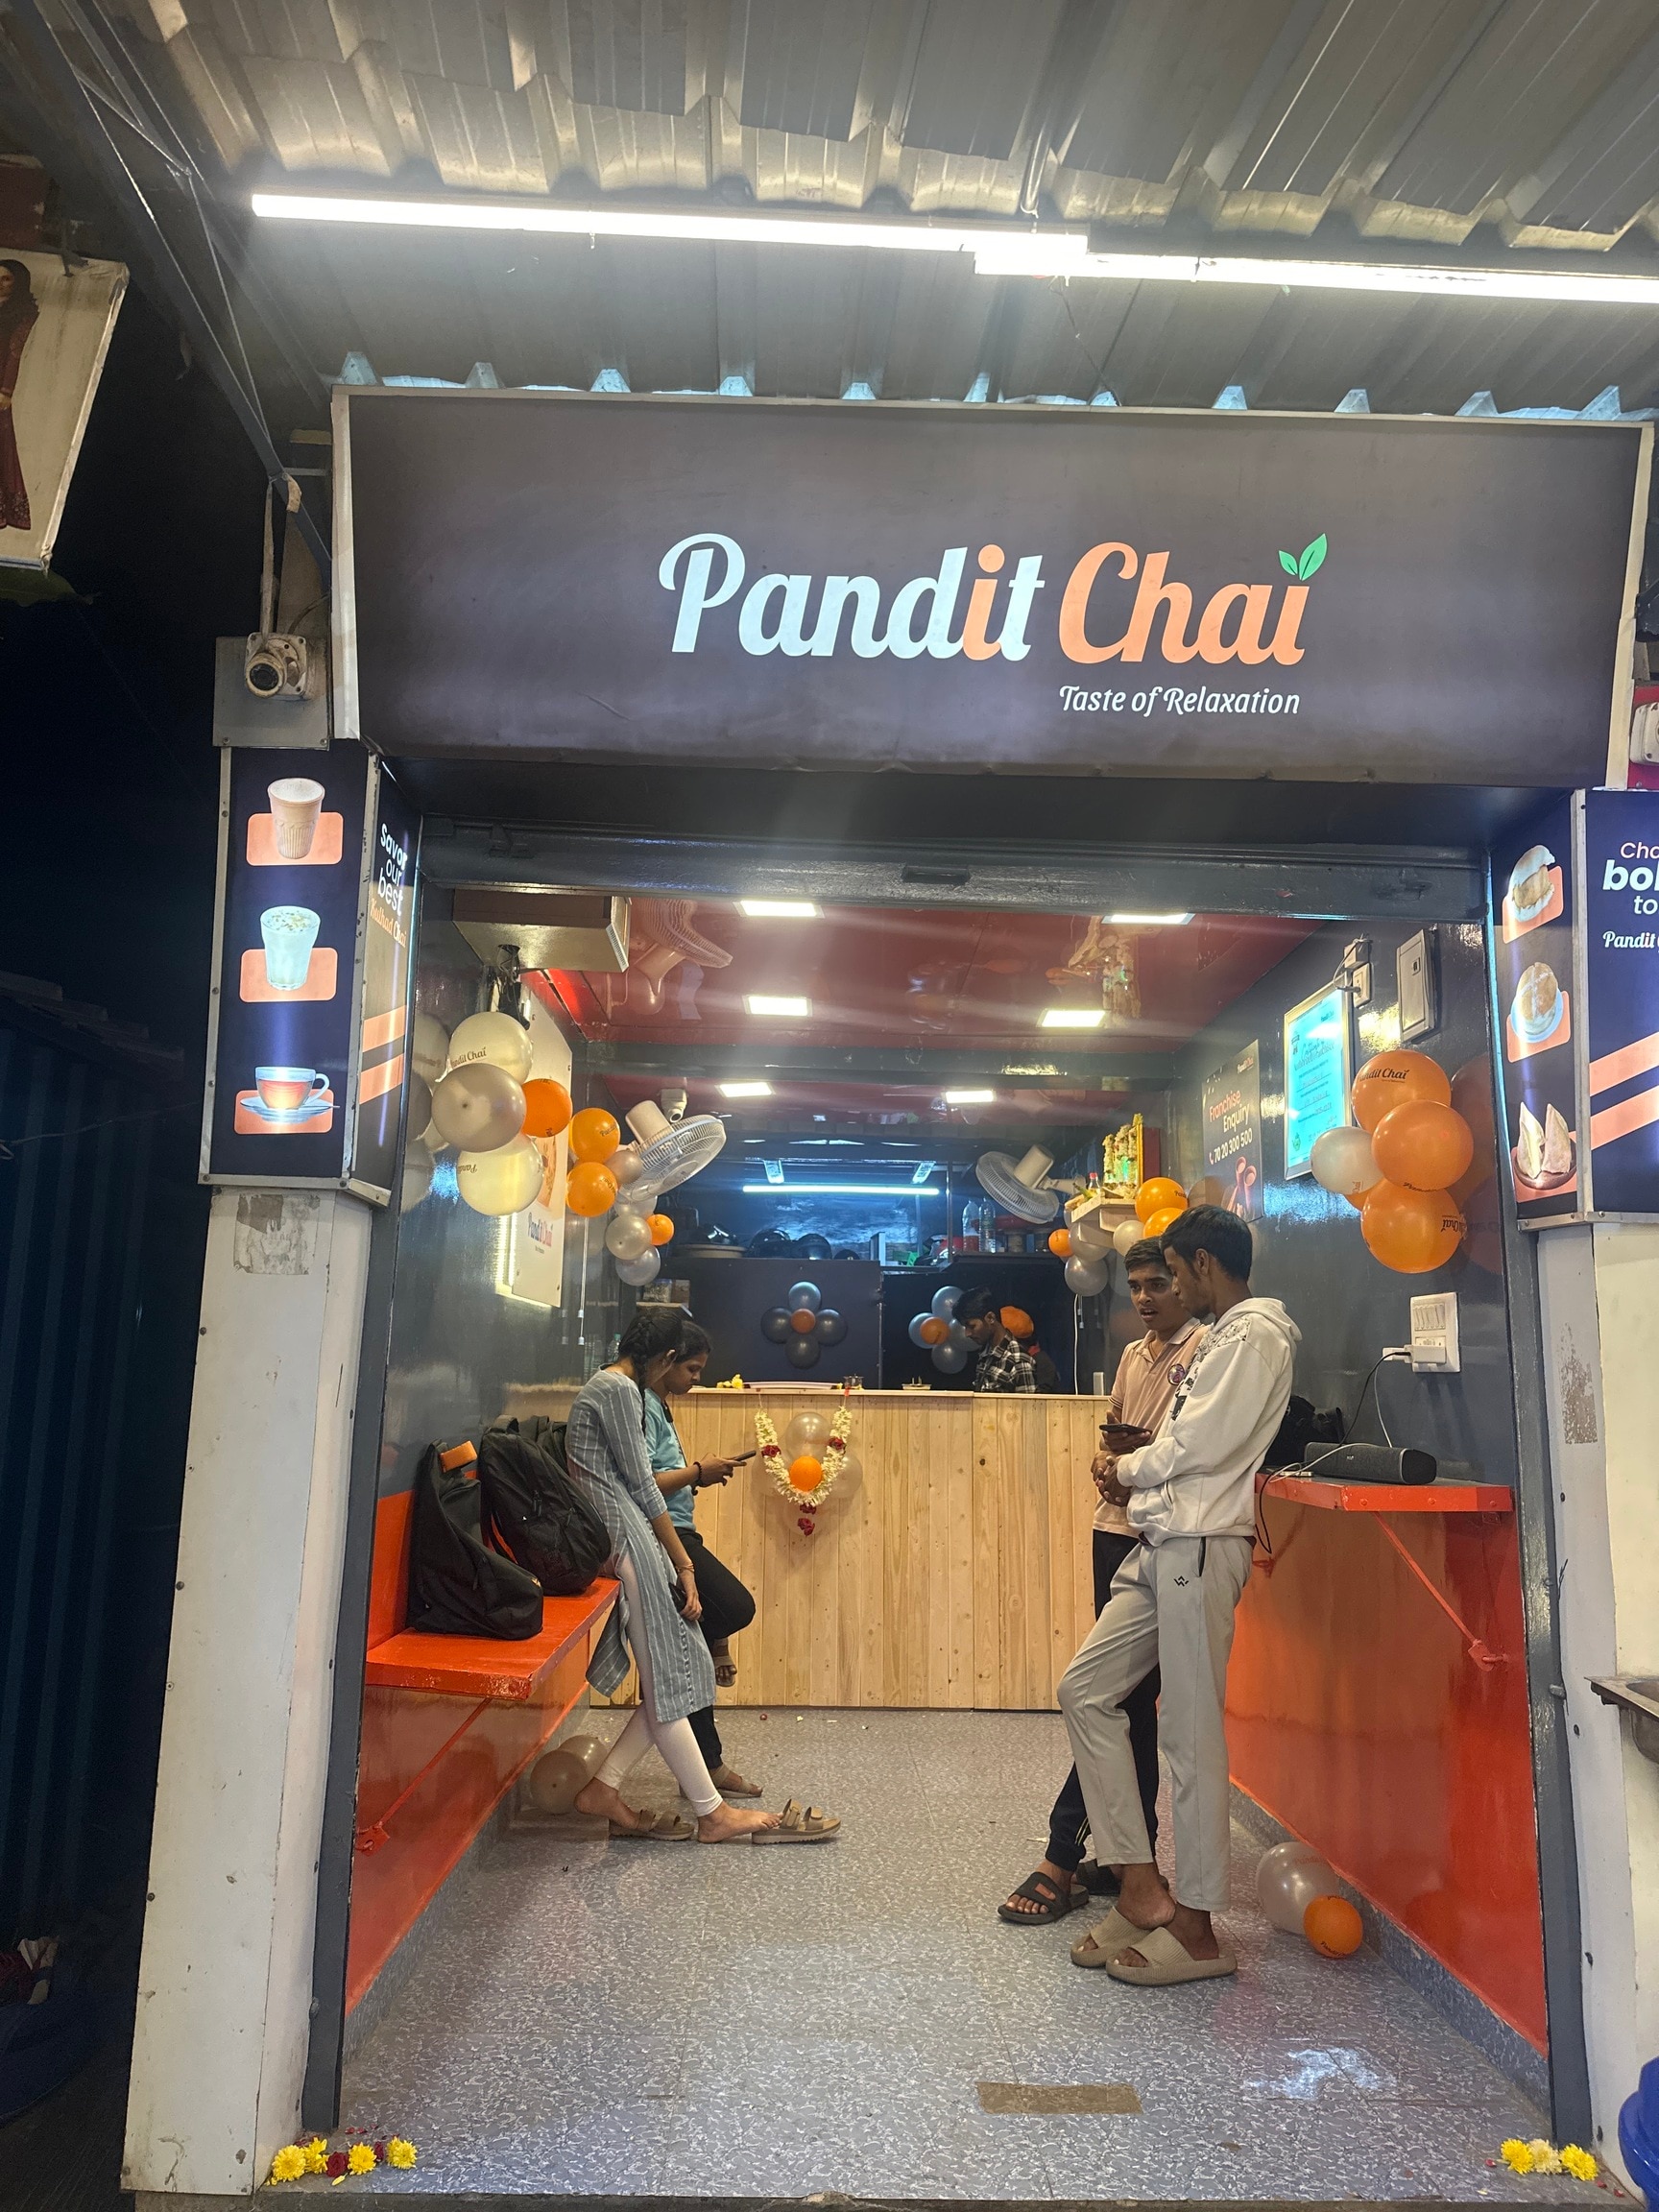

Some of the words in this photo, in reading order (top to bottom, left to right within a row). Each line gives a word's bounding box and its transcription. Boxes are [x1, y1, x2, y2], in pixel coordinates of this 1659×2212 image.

[659, 532, 1046, 661] Pandit
[1058, 533, 1328, 665] Chai
[1059, 685, 1127, 711] Taste
[1131, 685, 1163, 717] of
[1163, 685, 1300, 715] Relaxation
[380, 823, 408, 871] Savor
[386, 858, 402, 887] our
[377, 867, 403, 917] best
[1602, 930, 1657, 949] Pandit
[467, 1046, 487, 1061] Chai
[1382, 1067, 1409, 1080] Chai
[1209, 1090, 1241, 1123] Franchise
[1223, 1103, 1250, 1133] Enquiry
[1220, 1142, 1229, 1160] 20
[1228, 1135, 1240, 1155] 300
[1239, 1127, 1253, 1148] 500
